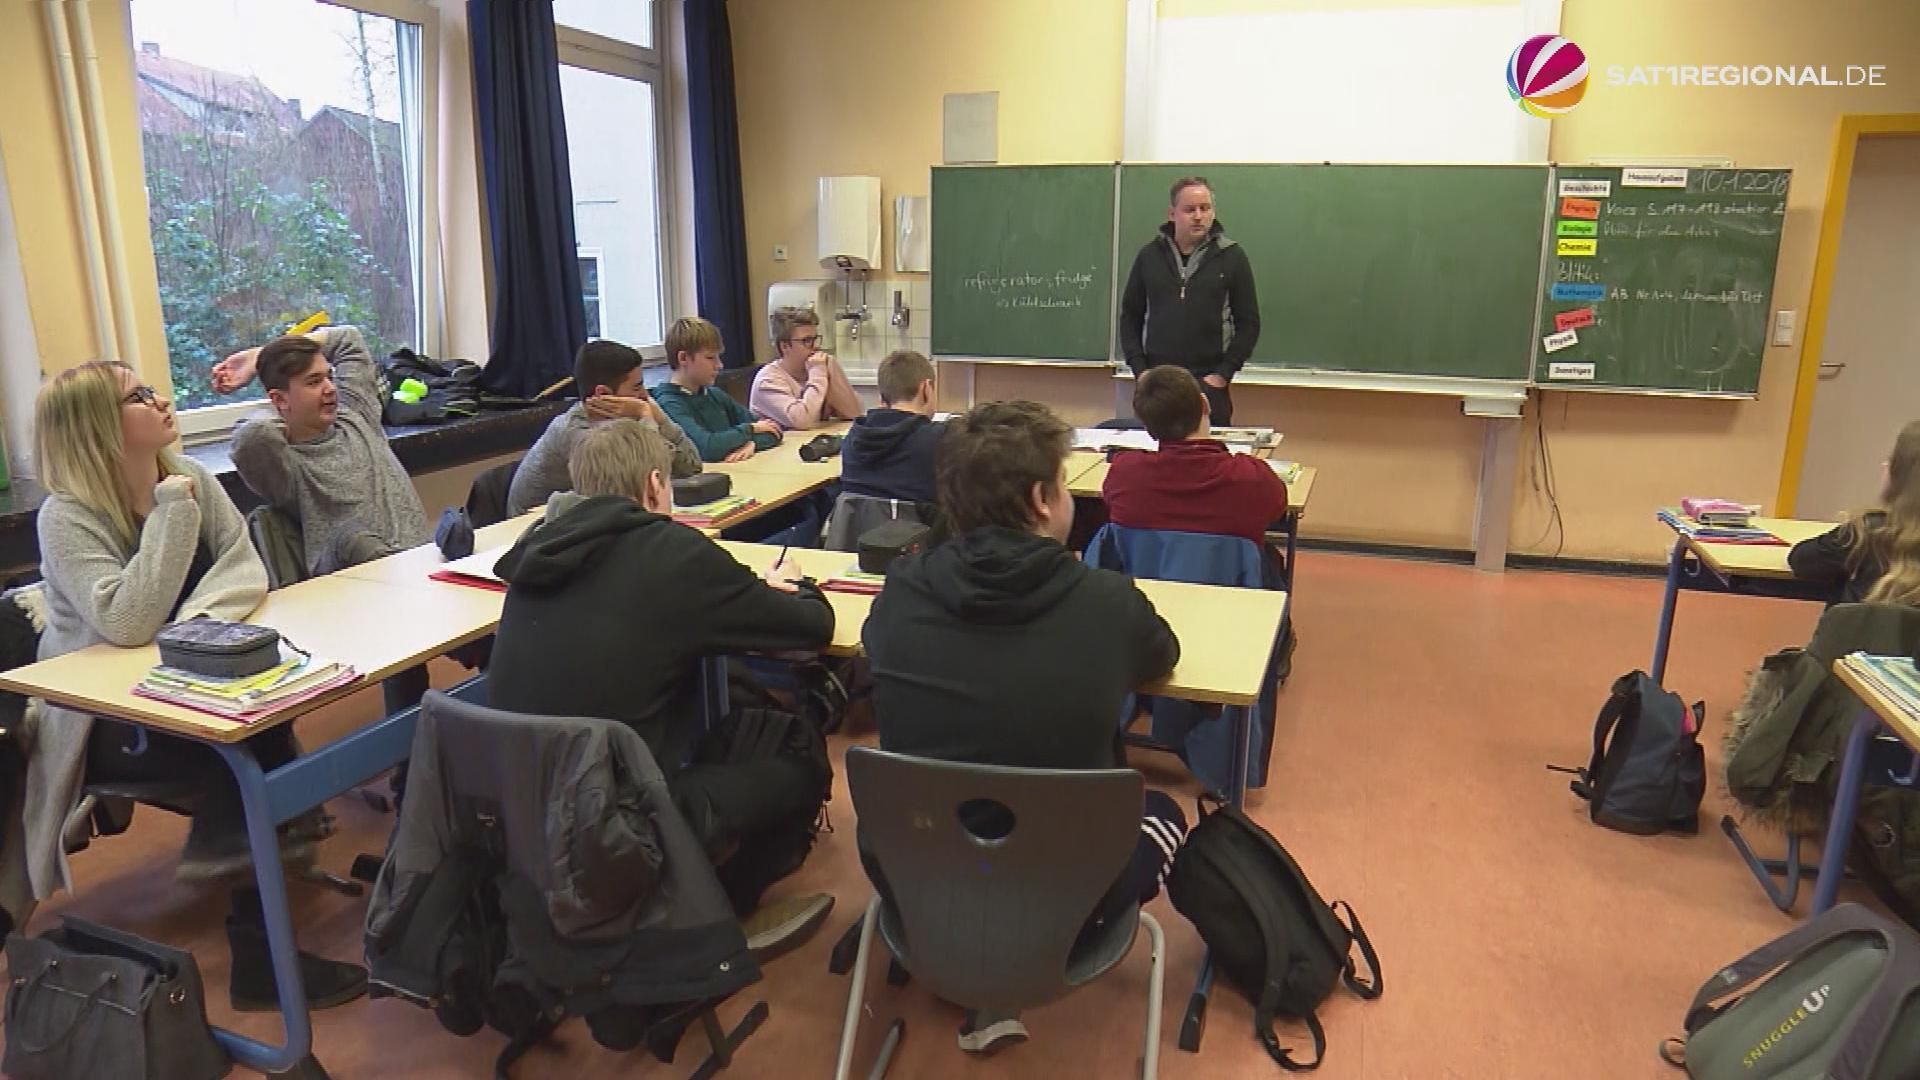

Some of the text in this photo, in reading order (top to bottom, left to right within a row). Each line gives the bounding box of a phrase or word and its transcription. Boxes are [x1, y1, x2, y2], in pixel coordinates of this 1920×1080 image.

[1560, 242, 1592, 251] Chemie
[1549, 334, 1574, 346] Physik
[1553, 366, 1592, 375] Sonstiges
